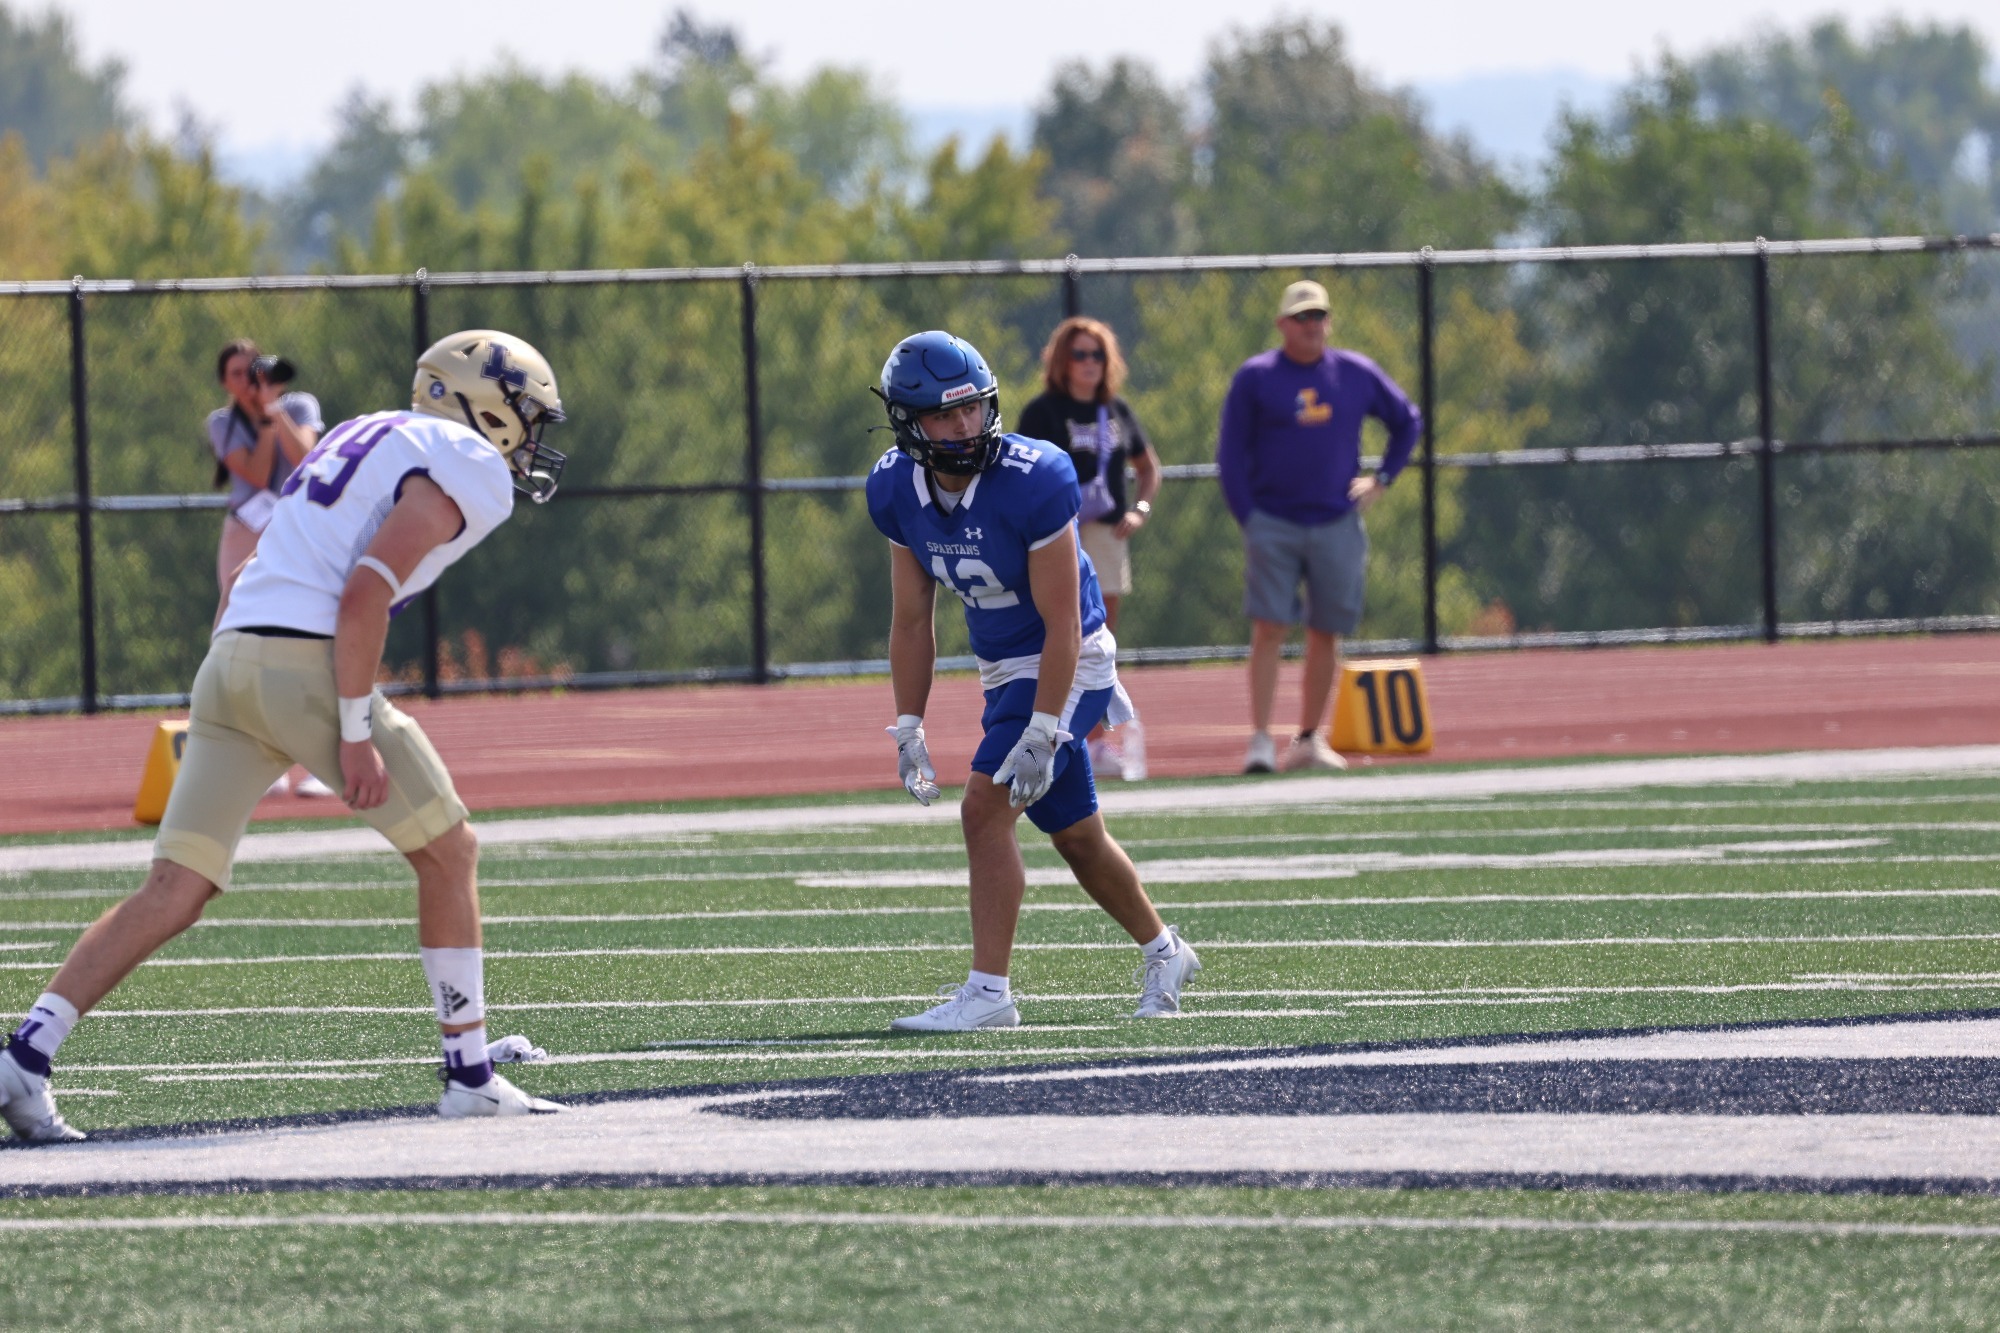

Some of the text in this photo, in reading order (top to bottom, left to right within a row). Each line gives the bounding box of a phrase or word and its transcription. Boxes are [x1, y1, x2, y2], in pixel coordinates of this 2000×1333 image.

[480, 339, 528, 390] L
[945, 385, 973, 399] Riddell
[1001, 444, 1043, 475] 12
[926, 541, 980, 556] SPARTANS
[931, 555, 1020, 609] 12
[1356, 670, 1424, 744] 10
